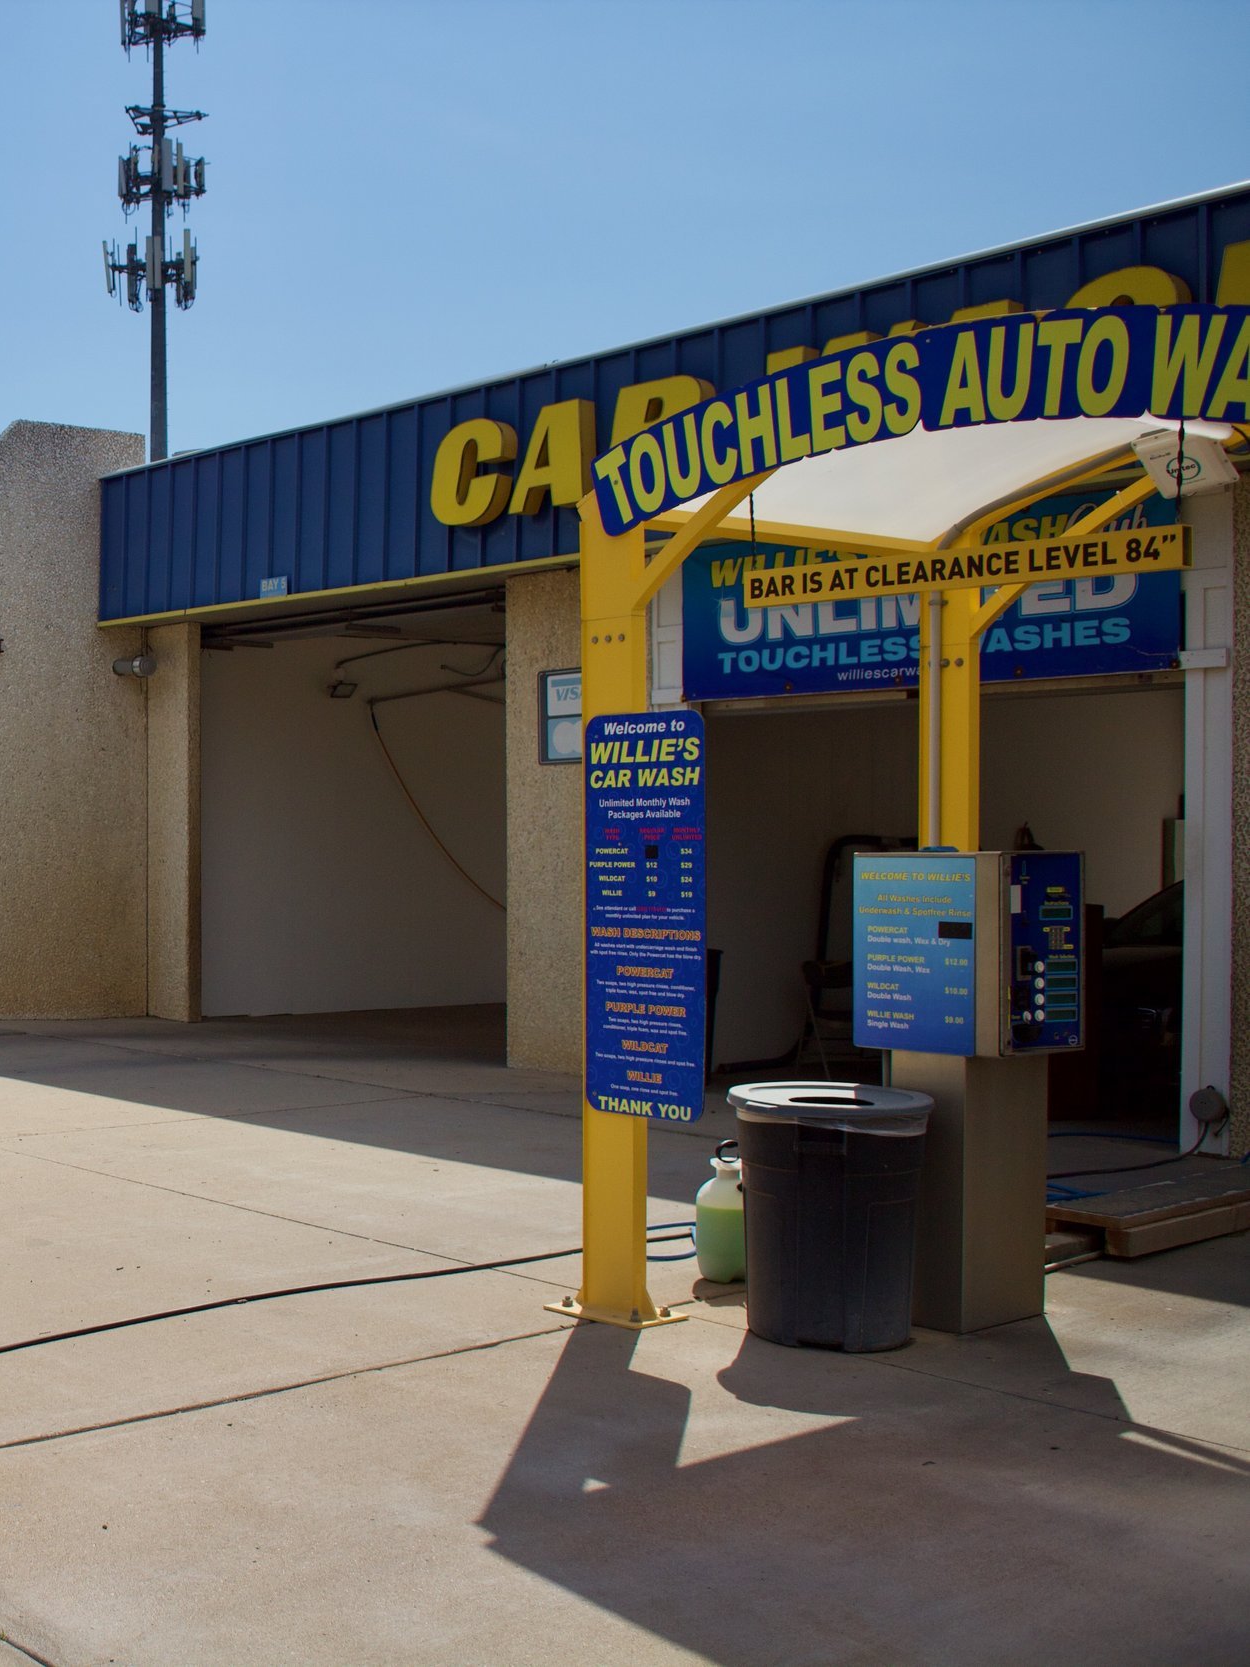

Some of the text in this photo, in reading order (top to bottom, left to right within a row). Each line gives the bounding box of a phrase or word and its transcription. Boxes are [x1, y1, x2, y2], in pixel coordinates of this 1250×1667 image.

[594, 342, 921, 525] TOUCHLESS
[939, 315, 1129, 427] AUTO
[750, 574, 795, 599] BAR
[802, 571, 823, 594] IS
[829, 567, 858, 592] AT
[865, 551, 1019, 588] CLEARANCE
[1029, 541, 1117, 572] LEVEL
[261, 578, 278, 592] BAY
[980, 617, 1131, 653] ASHES
[556, 686, 582, 701] VIS
[604, 719, 684, 735] Welcome to
[590, 737, 700, 765] WILLIE'S
[590, 767, 700, 789] CAR WASH
[599, 797, 690, 808] Unlimited Monthly Wash
[608, 810, 681, 820] Packages Available
[861, 872, 971, 882] WELCOME TO WILLIE'S
[878, 894, 952, 904] All Washes Include
[859, 906, 902, 916] Underwash
[904, 907, 910, 915] &
[948, 908, 971, 917] Rinse
[591, 927, 701, 941] WASH DESCRIPTIONS
[867, 926, 908, 934] POWERCAT
[867, 935, 891, 943] Double
[938, 938, 950, 947] Dry
[867, 954, 895, 962] PURPLE
[897, 955, 925, 963] POWER
[616, 965, 674, 979] POWERCAT
[915, 966, 930, 974] Wax
[867, 982, 900, 990] WILDCAT
[867, 992, 912, 1000] Double Wash
[605, 1001, 686, 1017] PURPLE POWER
[867, 1010, 914, 1020] WILLIE WASH
[867, 1020, 909, 1029] Single Wash
[621, 1040, 668, 1054] WILDCAT
[626, 1070, 662, 1084] WILLIE
[598, 1096, 691, 1121] THANK YOU
